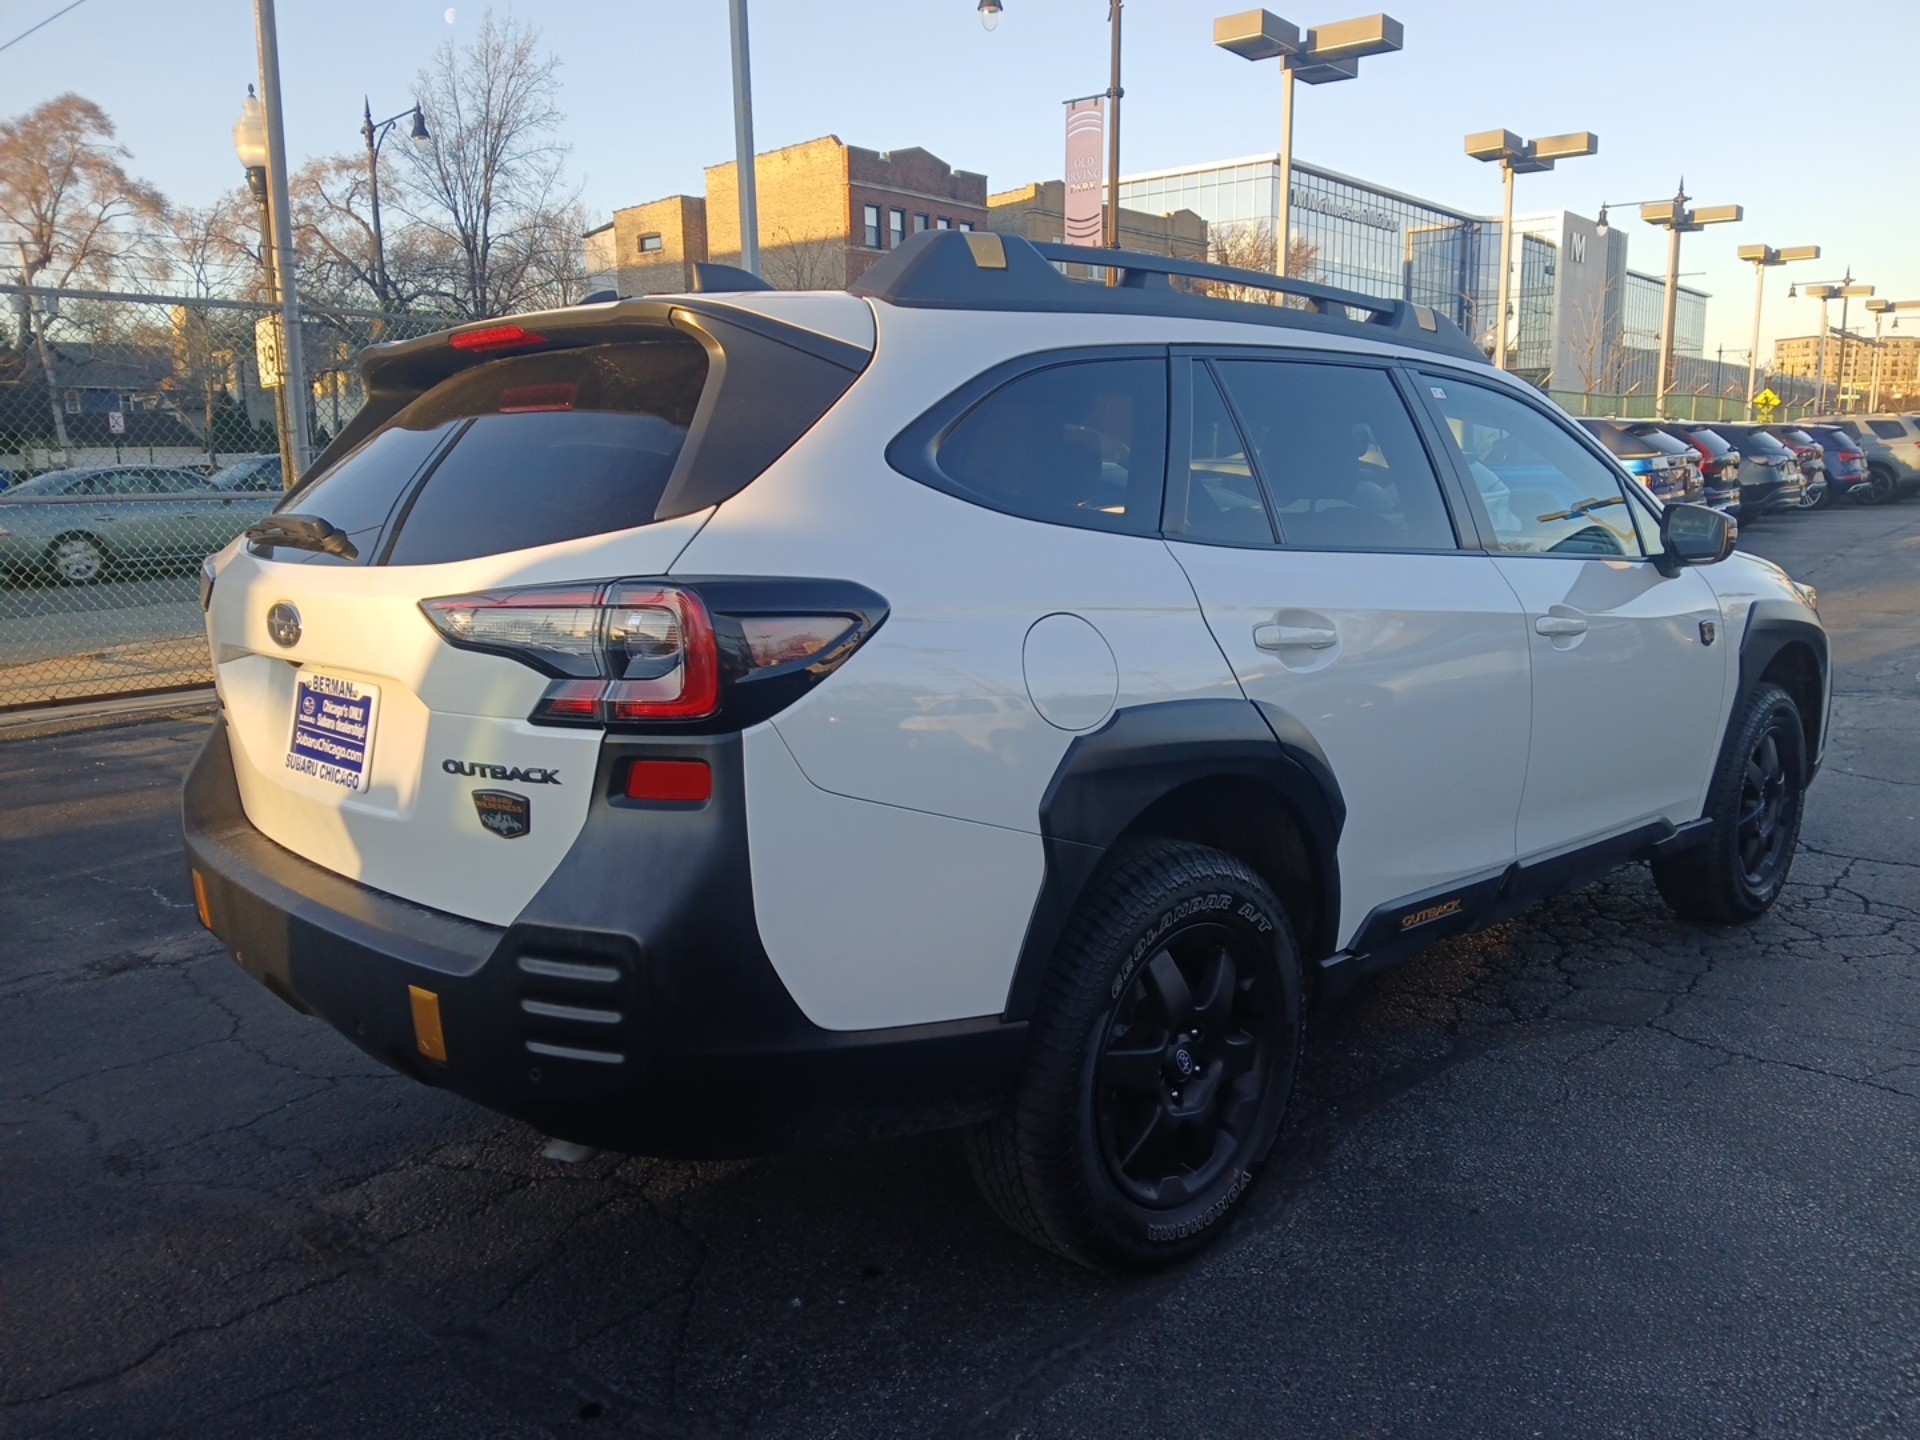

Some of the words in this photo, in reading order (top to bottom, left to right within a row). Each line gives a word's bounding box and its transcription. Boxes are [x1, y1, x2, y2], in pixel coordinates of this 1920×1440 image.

[1067, 169, 1101, 182] IRVING
[1074, 156, 1095, 168] OLD
[313, 675, 354, 698] BERMAN
[295, 731, 362, 763] SubaruChicago.com
[286, 754, 318, 776] SUBARU
[319, 765, 360, 790] CHICAGO
[442, 758, 563, 785] OUTBACK
[1402, 899, 1461, 926] OUTBACK
[1111, 894, 1233, 999] GEOLANDAR
[1238, 902, 1272, 932] A/T
[1148, 1170, 1253, 1241] YOKOHAMA
